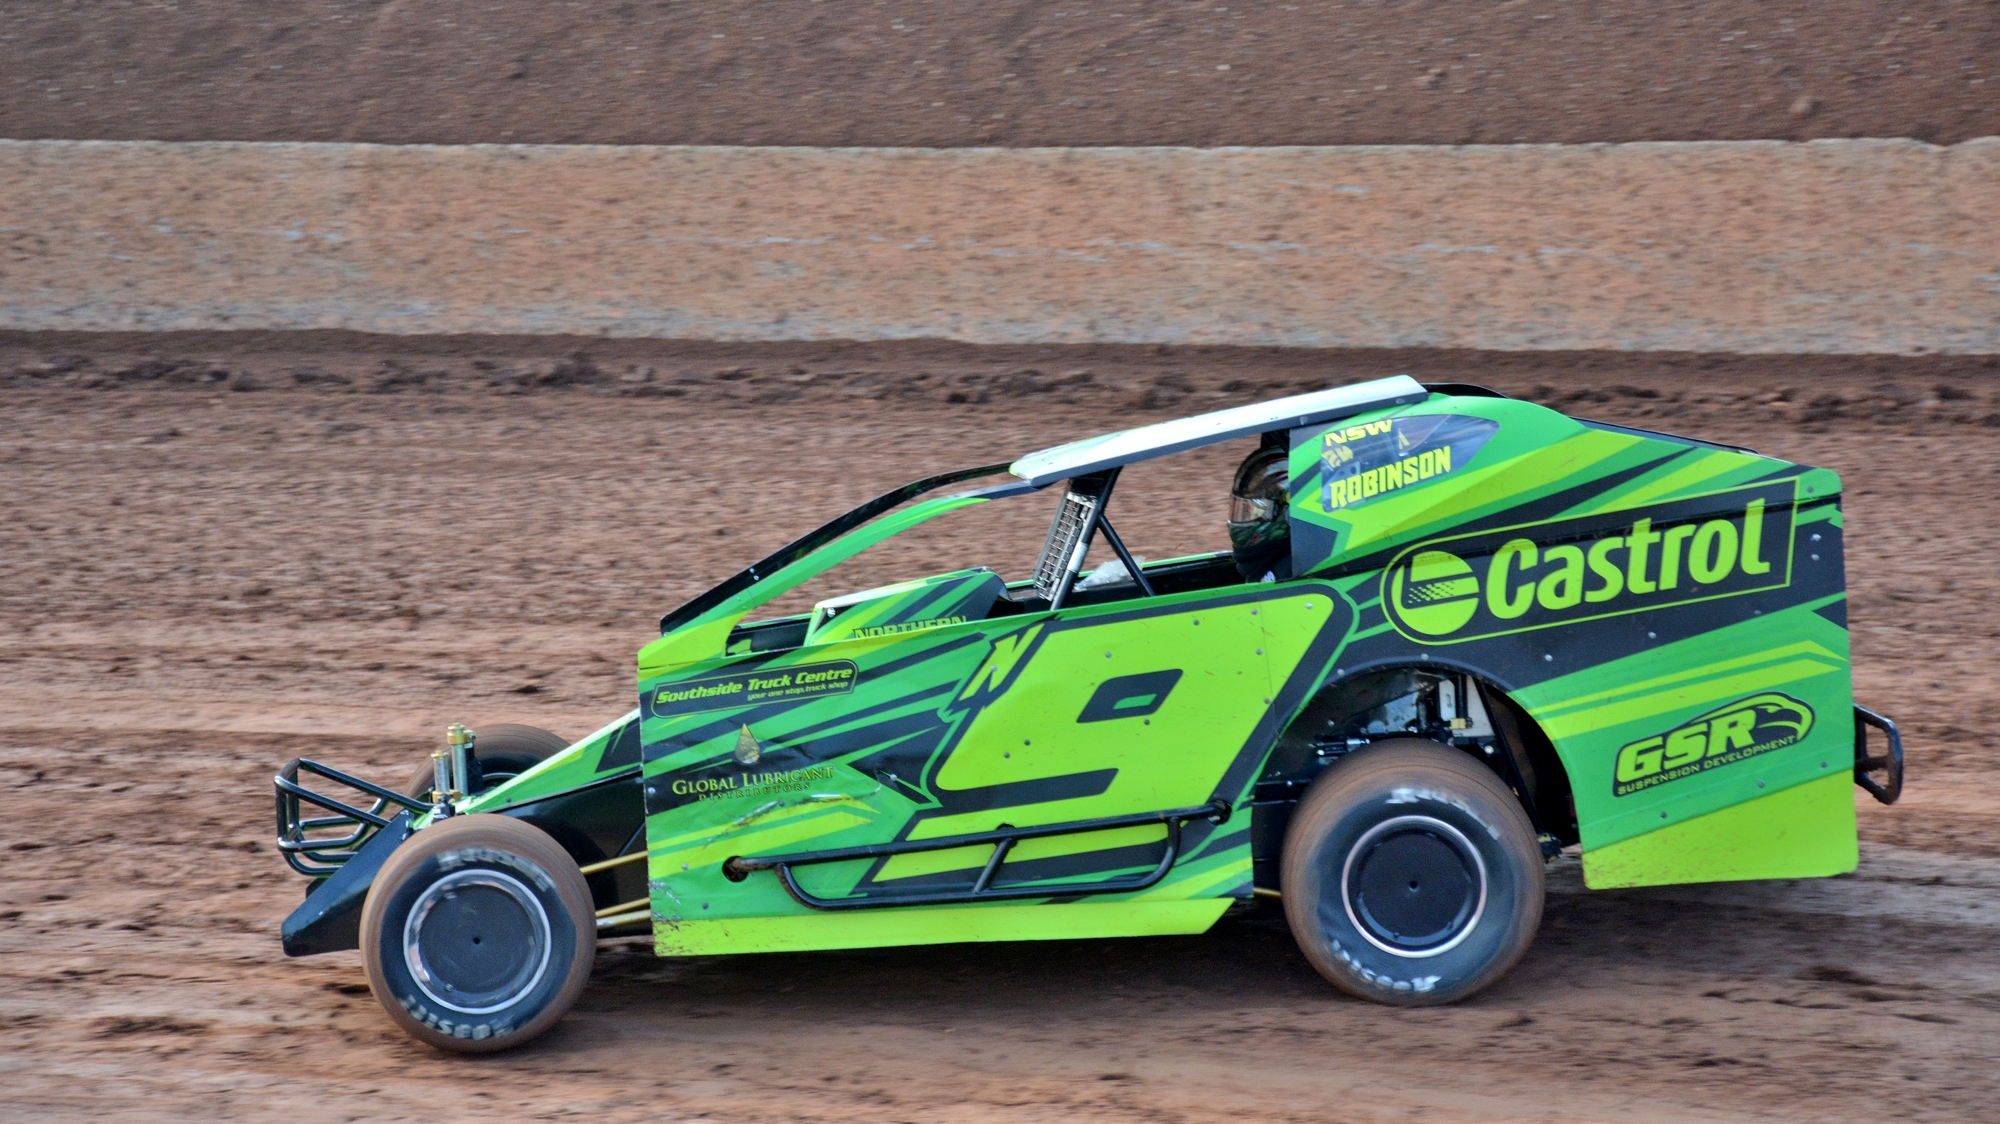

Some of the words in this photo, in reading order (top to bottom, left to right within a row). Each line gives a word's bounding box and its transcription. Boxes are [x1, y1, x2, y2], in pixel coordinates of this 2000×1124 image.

[1325, 419, 1392, 447] NSW
[1329, 446, 1451, 508] ROBINSON
[1486, 498, 1770, 619] Castrol
[656, 682, 743, 704] Southside
[747, 674, 792, 691] Truck
[795, 669, 853, 685] Centre
[1616, 709, 1757, 783] GSR
[1617, 763, 1700, 796] SUSPENSION
[1703, 734, 1797, 770] DEVELOPMENT
[698, 782, 811, 802] DISTRIBUTORS
